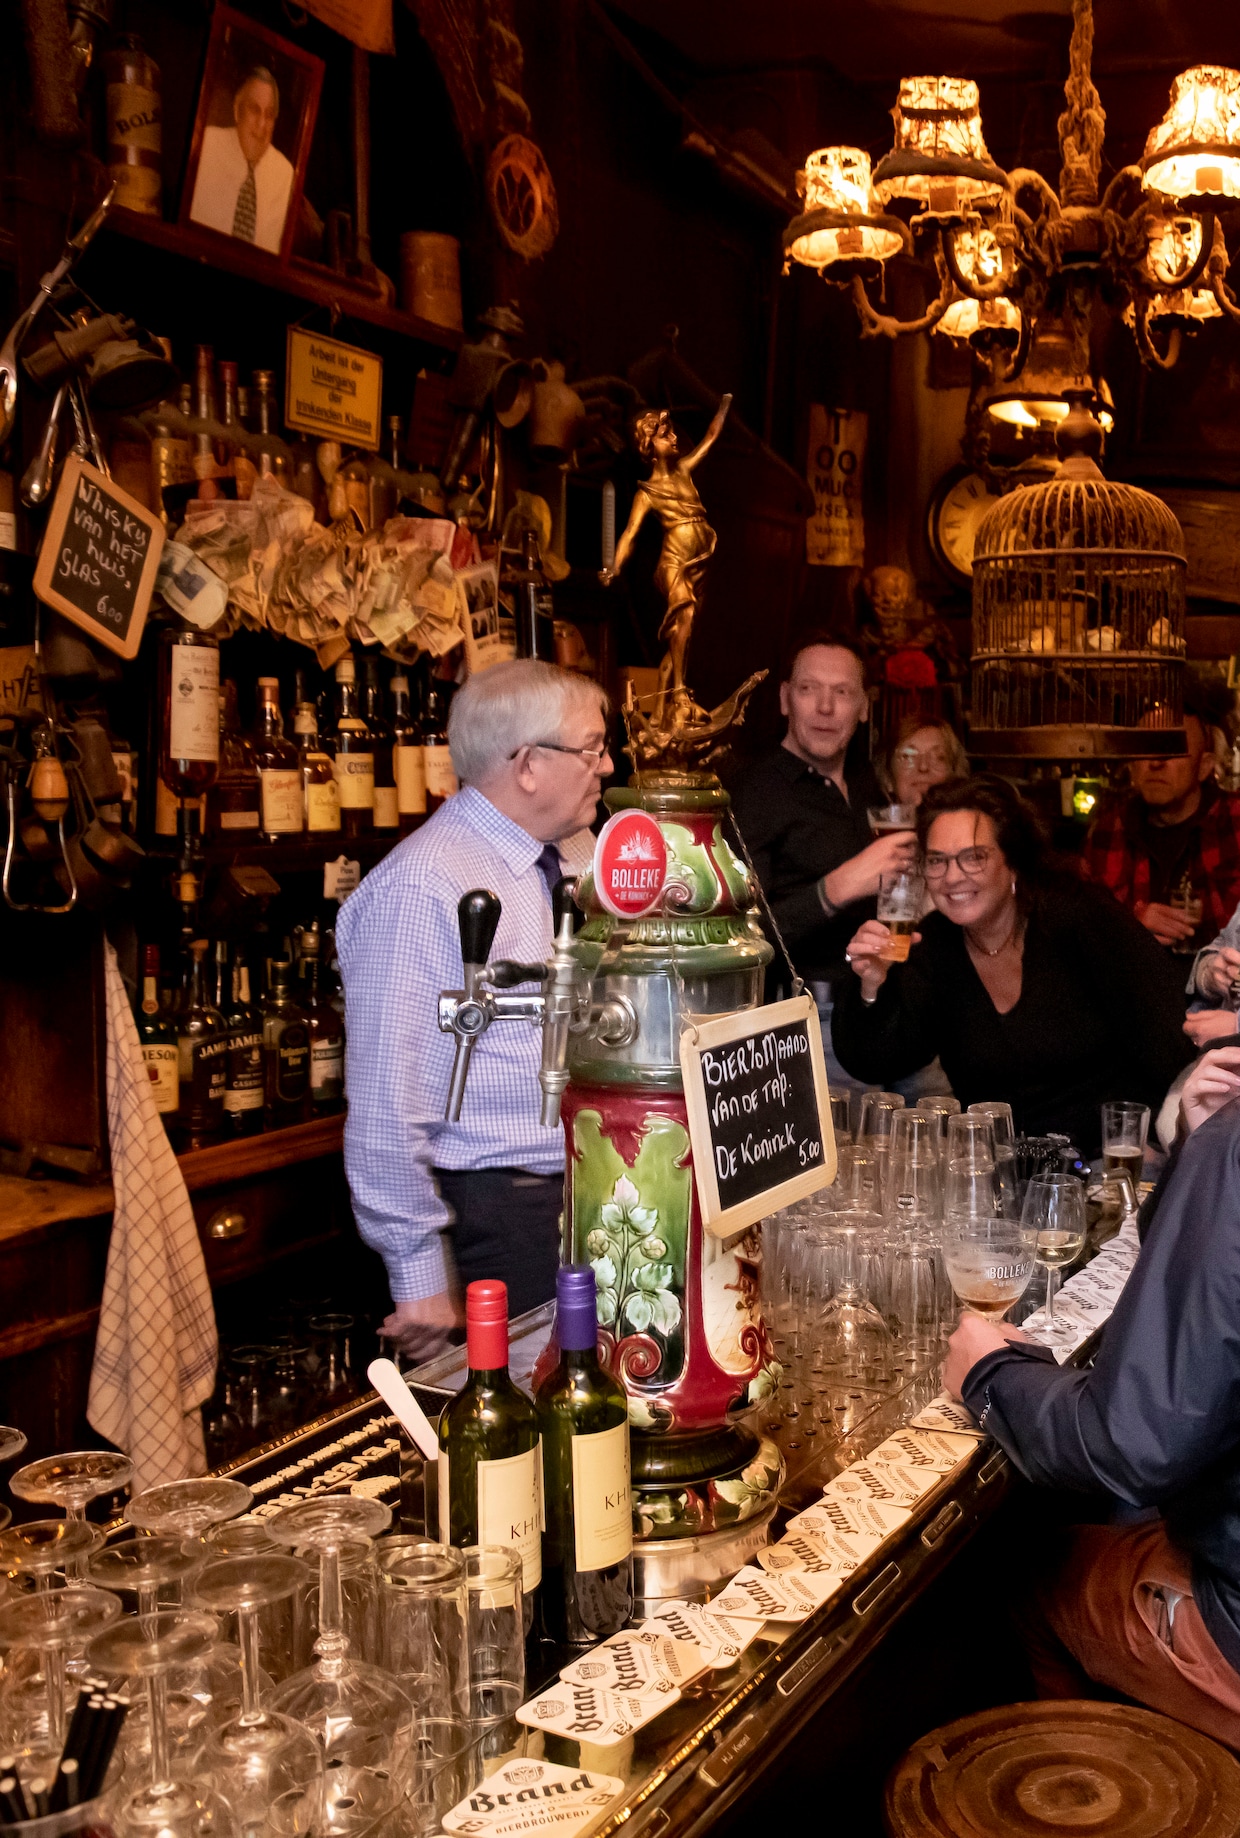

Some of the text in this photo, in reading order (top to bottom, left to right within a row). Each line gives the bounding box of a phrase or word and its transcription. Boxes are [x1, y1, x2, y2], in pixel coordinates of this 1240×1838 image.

[611, 868, 661, 889] BOLLEKE
[742, 1088, 759, 1114] DE
[798, 1137, 821, 1167] 5.00
[889, 1435, 935, 1467] Brand
[848, 1467, 895, 1500] Brand
[780, 1537, 832, 1574] Brand
[734, 1579, 787, 1616] Brand
[602, 1640, 646, 1692] Brand
[469, 1773, 595, 1813] Brand
[495, 1809, 591, 1835] BIERBROUWERIJ
[520, 1806, 557, 1818] 1340
